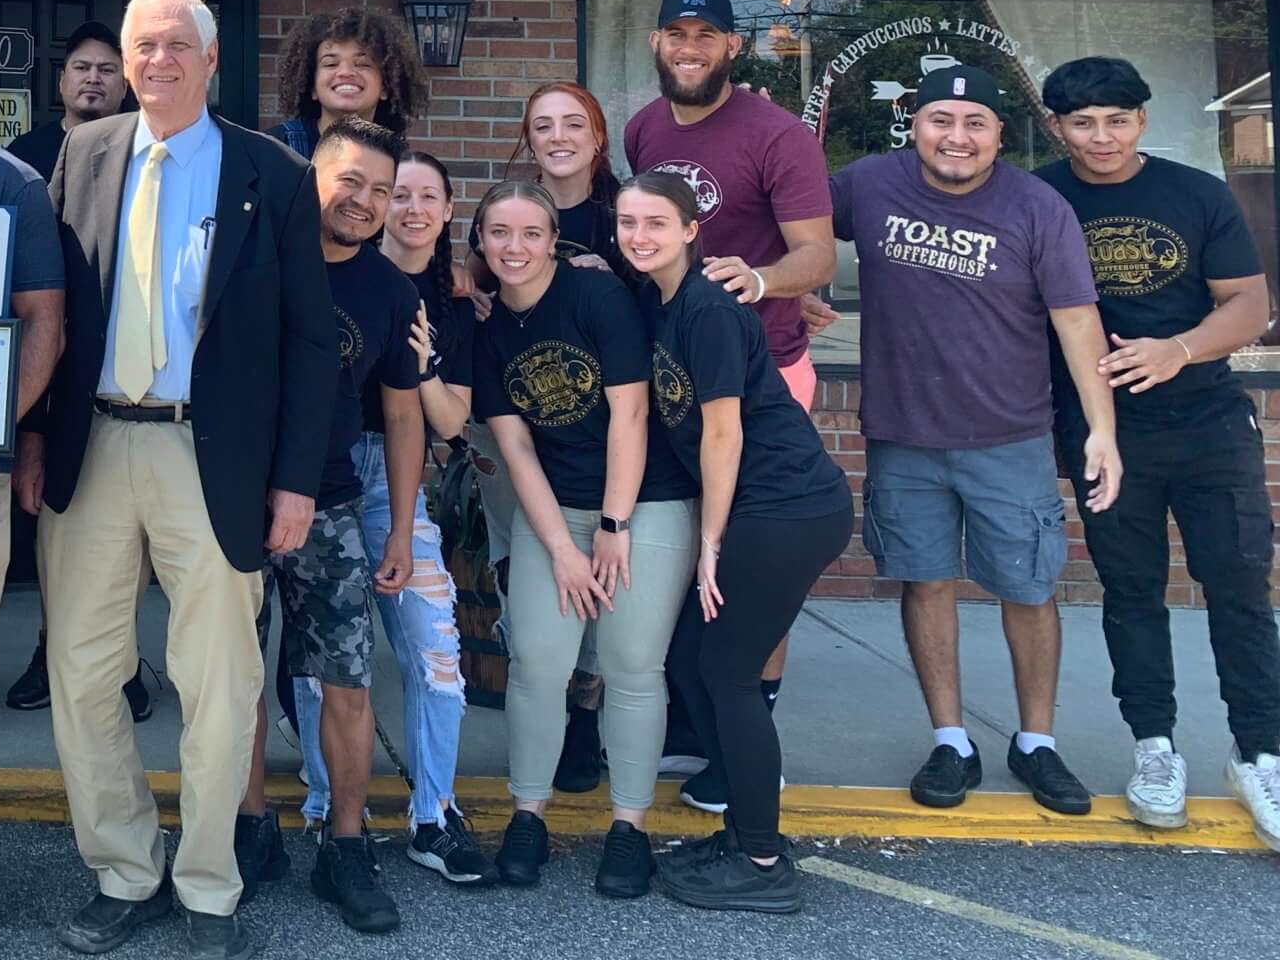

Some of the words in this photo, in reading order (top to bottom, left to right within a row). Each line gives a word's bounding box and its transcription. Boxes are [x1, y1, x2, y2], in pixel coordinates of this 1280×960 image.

[800, 85, 830, 134] FFEE
[831, 16, 933, 75] CAPPUCCINOS
[956, 18, 1021, 58] LATTES
[885, 215, 997, 264] TOAST
[1084, 226, 1157, 262] toast
[885, 243, 986, 278] COFFEEHOUSE
[1094, 263, 1150, 272] COFFEEHOUSE
